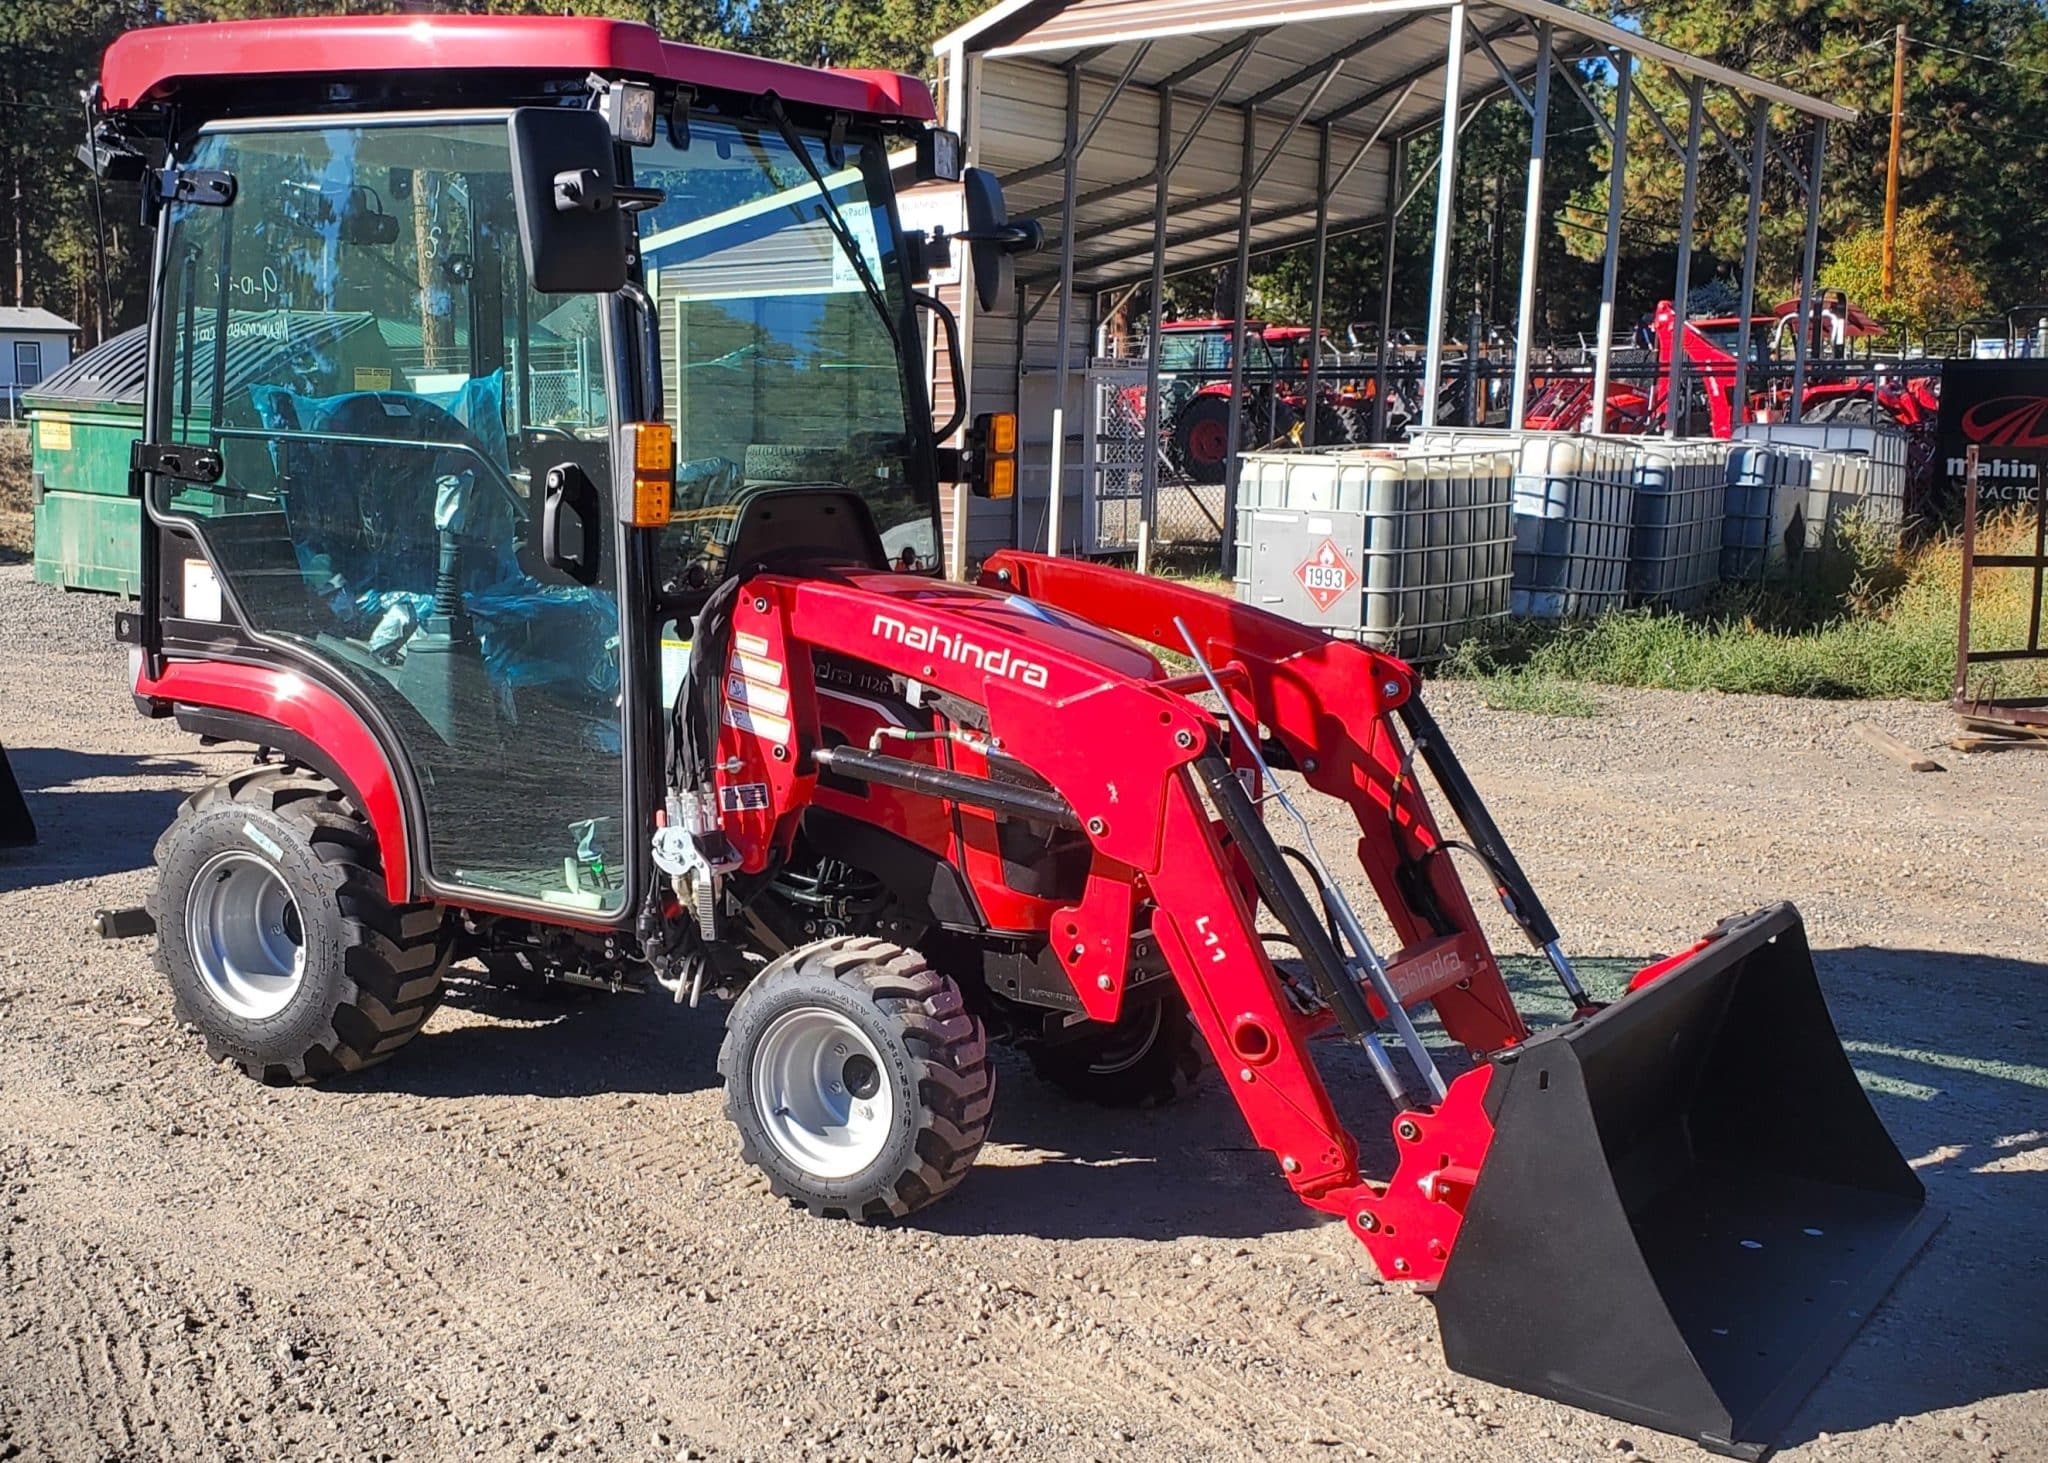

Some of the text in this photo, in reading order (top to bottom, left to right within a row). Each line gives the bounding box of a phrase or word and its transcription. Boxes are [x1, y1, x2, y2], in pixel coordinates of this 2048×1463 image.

[1309, 568, 1343, 588] 1993
[1319, 591, 1328, 601] 3
[871, 614, 1049, 690] mahindra
[860, 674, 889, 693] 1126
[1195, 915, 1227, 963] L11
[1397, 950, 1461, 997] ahindra
